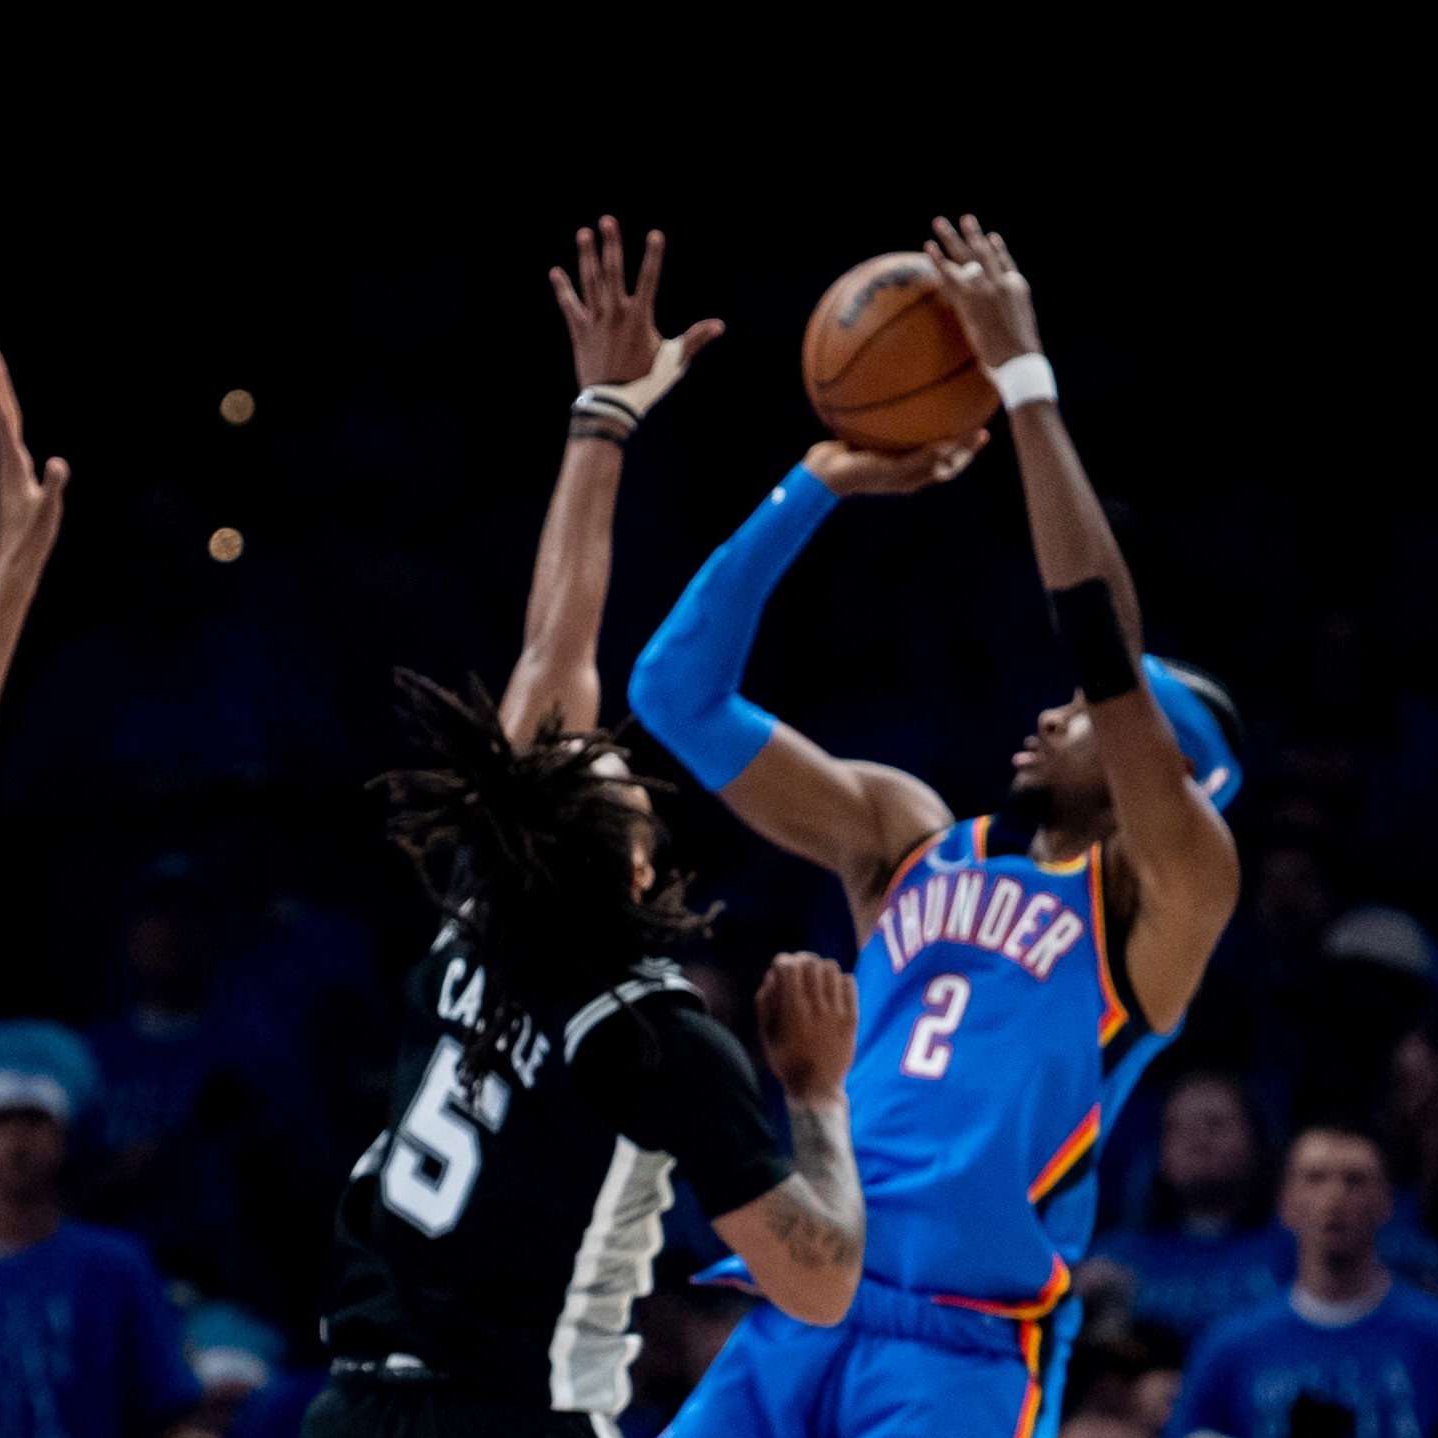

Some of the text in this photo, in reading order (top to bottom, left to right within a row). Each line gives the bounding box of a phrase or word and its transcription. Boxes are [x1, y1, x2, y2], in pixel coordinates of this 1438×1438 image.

[877, 868, 1086, 982] THUNDER
[900, 972, 972, 1081] 2
[379, 1032, 512, 1240] 5
